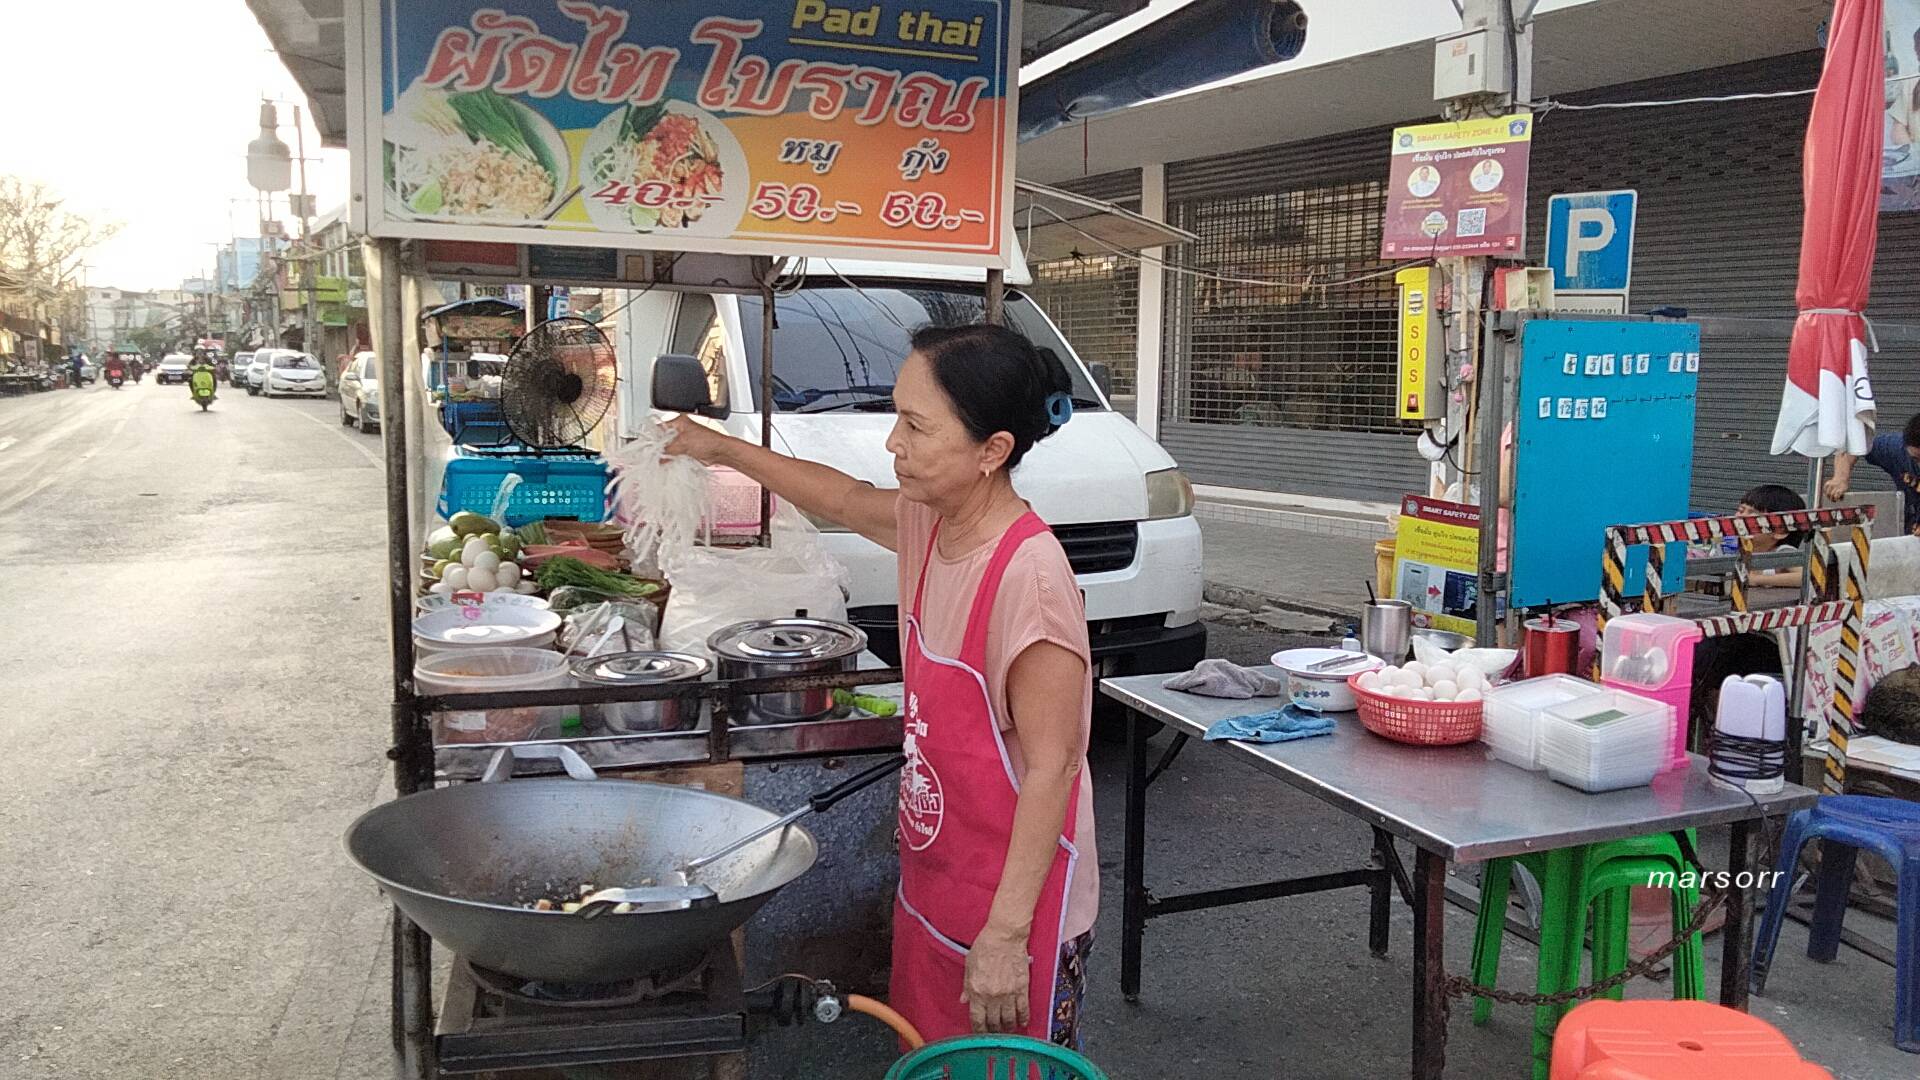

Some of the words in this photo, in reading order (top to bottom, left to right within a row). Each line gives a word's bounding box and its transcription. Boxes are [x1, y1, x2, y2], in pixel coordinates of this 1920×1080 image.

[792, 0, 881, 36] Pad
[898, 11, 984, 47] thai
[421, 4, 681, 107] ผัดไท
[693, 14, 990, 131] โบราณ
[780, 138, 841, 173] หมู
[901, 137, 948, 179] กุ้ง
[1565, 207, 1616, 278] P
[1409, 325, 1420, 383] SOS
[1443, 509, 1468, 519] SAFETY
